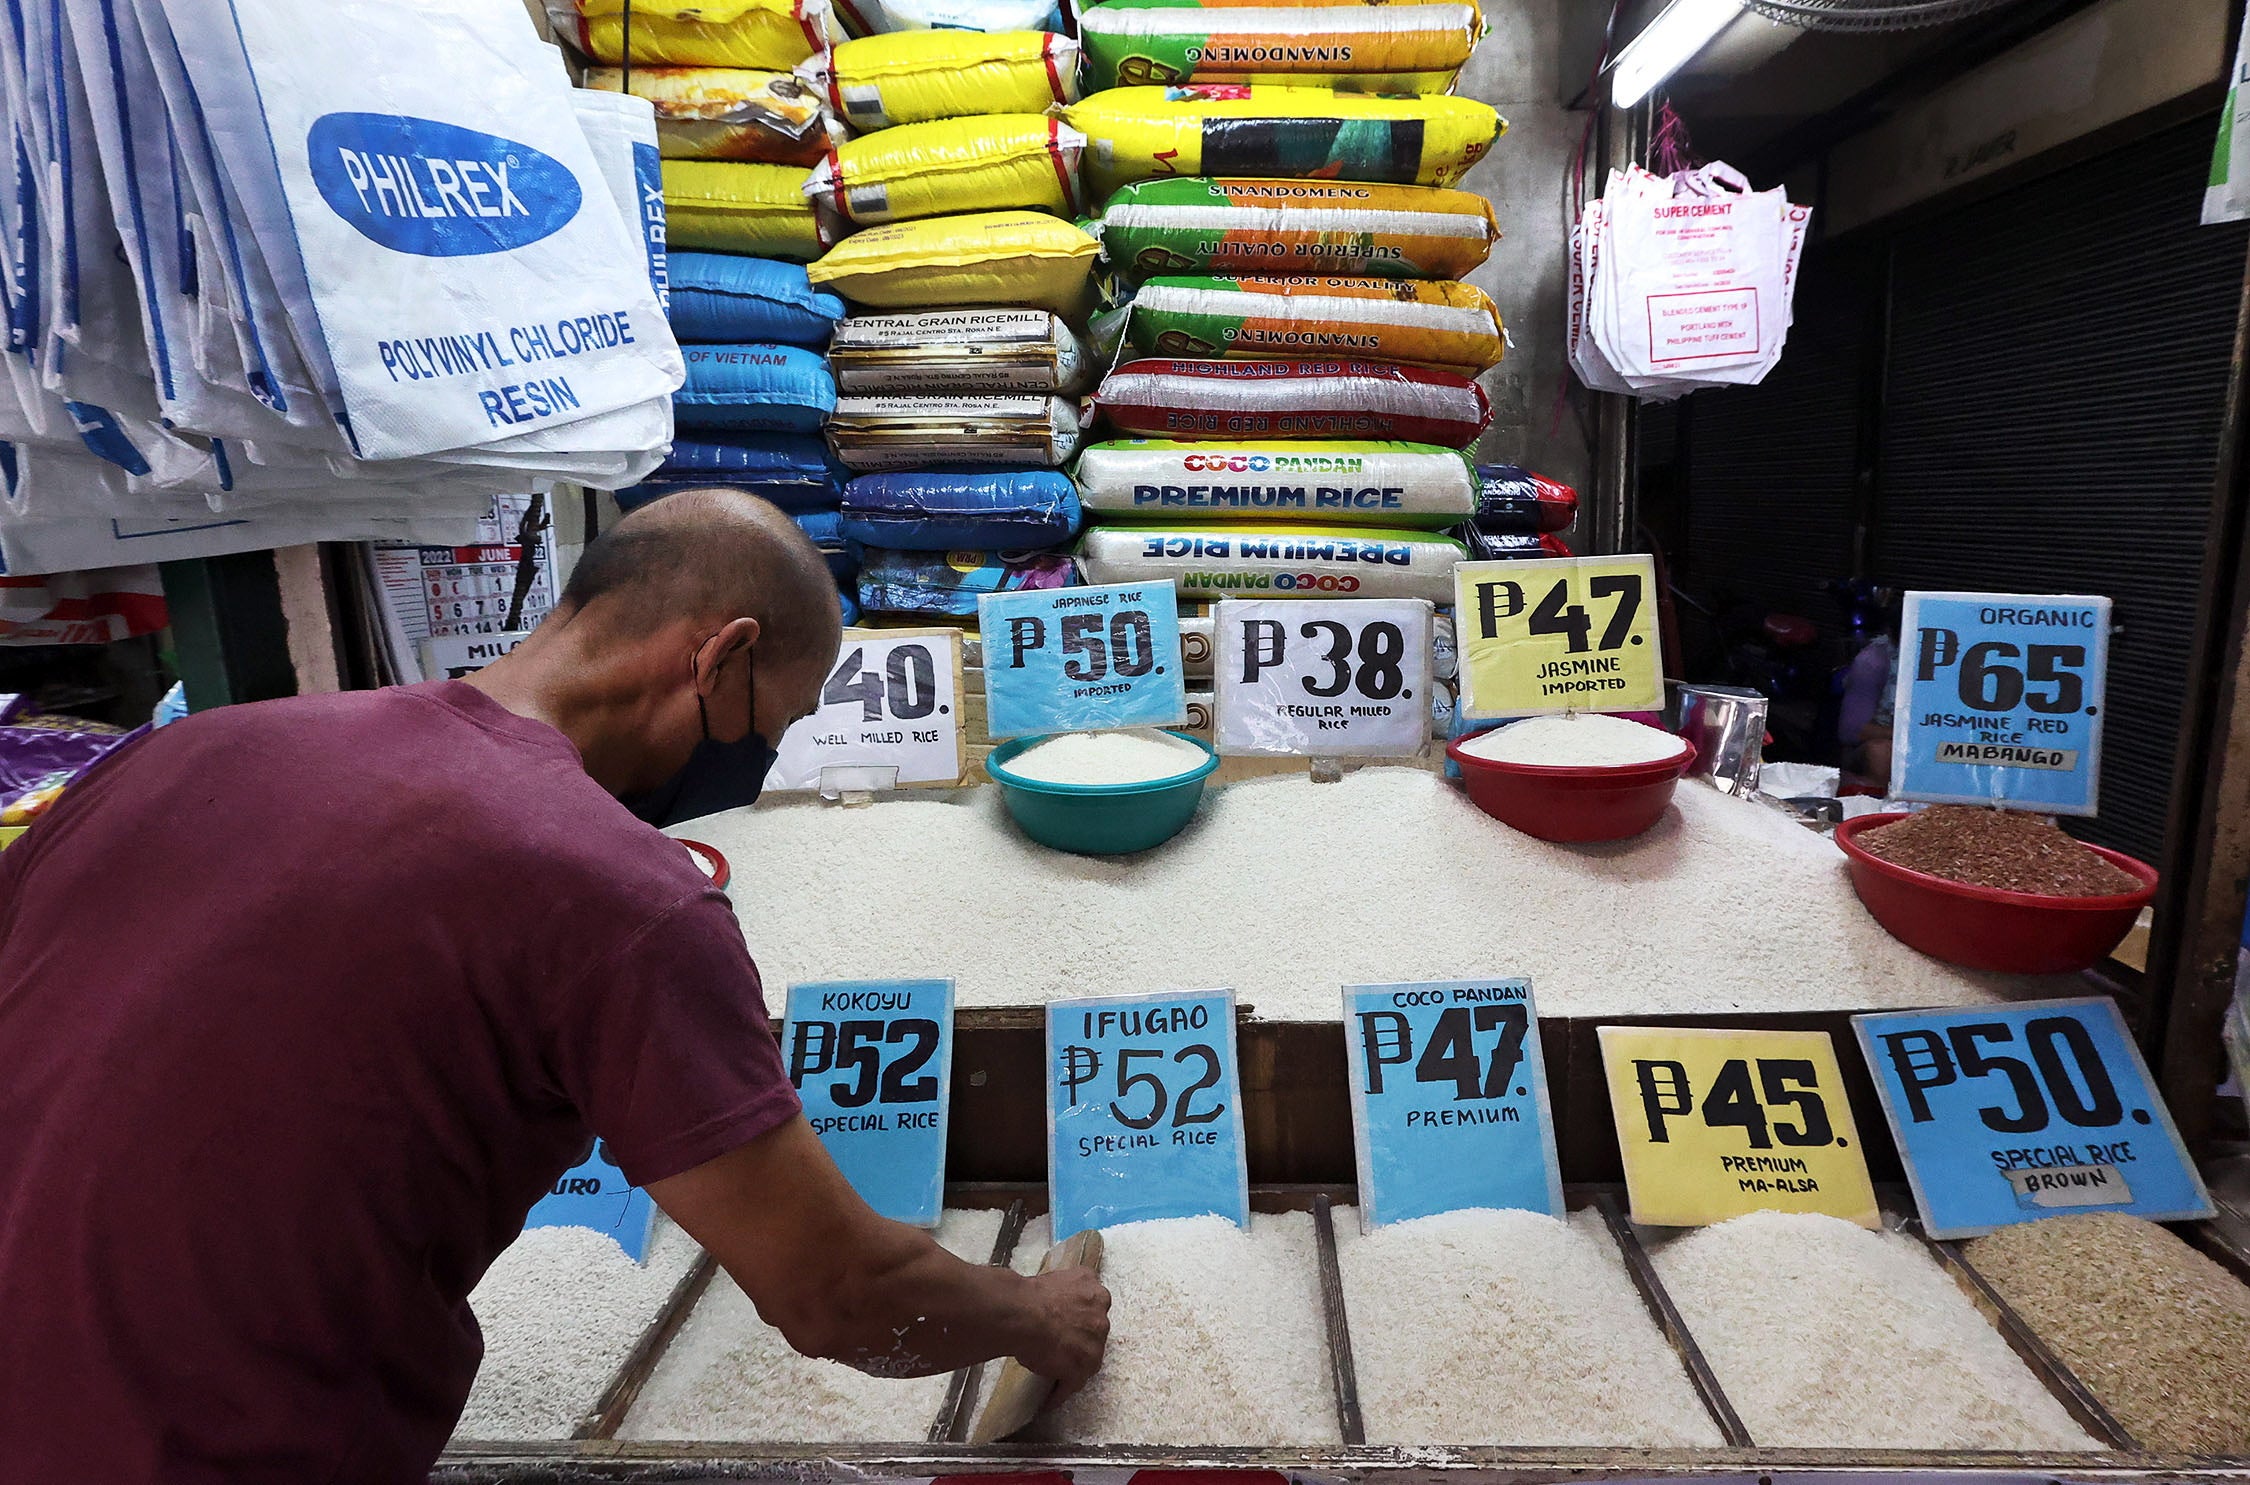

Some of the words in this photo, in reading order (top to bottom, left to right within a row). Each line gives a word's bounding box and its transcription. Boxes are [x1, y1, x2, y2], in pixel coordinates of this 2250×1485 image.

[1184, 46, 1352, 62] SINANDOMENG
[338, 146, 530, 218] PHILREX
[1208, 184, 1370, 198] SINANDOMENG
[1654, 205, 1690, 218] SUPER
[1691, 203, 1732, 217] CEMENT
[1196, 240, 1287, 256] QUALITY
[1295, 242, 1402, 259] SUPERIOR
[1211, 274, 1320, 287] SUPERIOR
[1325, 277, 1417, 293] QUALITY
[842, 318, 914, 329] CENTRAL
[917, 317, 967, 327] GRAIN
[969, 313, 1043, 324] RICEMILL
[378, 331, 514, 383] POLYVINYL
[510, 310, 635, 363] CHLORIDE
[1222, 327, 1379, 348] SINANDOMENG
[688, 351, 710, 363] OF
[715, 352, 788, 367] VIETNAM
[1172, 361, 1290, 377] HIGHLAND
[1298, 363, 1341, 375] RED
[1350, 362, 1401, 377] RICE
[478, 376, 581, 428] RESIN
[1167, 413, 1218, 431] RICE
[1228, 415, 1269, 432] RED
[1279, 415, 1393, 432] HIGHLAND
[1184, 454, 1271, 473] COCO
[1275, 456, 1363, 474] PANDAN
[1133, 485, 1312, 508] PREMIUM
[1316, 486, 1404, 509] RICE
[421, 551, 452, 563] 2022
[478, 548, 512, 561] JUNE
[1143, 536, 1231, 559] RICE
[1240, 536, 1412, 566] PREMIUM
[1183, 571, 1270, 589] PANDAN
[1275, 572, 1361, 593] COCO
[434, 605, 443, 620] 5
[453, 603, 463, 618] 6
[475, 600, 485, 615] 7
[497, 598, 507, 613] 8
[1051, 594, 1111, 609] JAPANESE
[1118, 591, 1143, 603] RICE
[1979, 606, 2094, 629] ORGANIC
[1536, 657, 1621, 679] JASMINE
[1073, 682, 1132, 699] IMPORTED
[1541, 677, 1627, 696] IMPORTED
[1276, 703, 1345, 719] REGULAR
[1350, 704, 1393, 718] MILLED
[1318, 719, 1349, 731] RICE
[1919, 713, 2013, 731] JASMINE
[2026, 717, 2069, 734] RED
[812, 732, 848, 746] WELL
[860, 732, 904, 744] MILLED
[912, 729, 939, 743] RICE
[1980, 731, 2024, 744] RICE
[1942, 743, 2065, 767] MABANGO
[821, 990, 912, 1012] KOKOYU
[1392, 989, 1445, 1009] COCO
[1452, 985, 1528, 1004] PANDAN
[1083, 1004, 1209, 1040] IFUGAO
[811, 1114, 890, 1136] SPECIAL
[896, 1111, 941, 1131] RICE
[1406, 1106, 1521, 1128] PREMIUM
[1078, 1133, 1161, 1158] SPECIAL
[1171, 1131, 1219, 1147] RICE
[1721, 1156, 1809, 1174] PREMIUM
[1990, 1144, 2078, 1171] SPECIAL
[2085, 1141, 2138, 1164] RICE
[1737, 1177, 1820, 1194] MA-ALSA
[2024, 1167, 2110, 1193] BROWN
